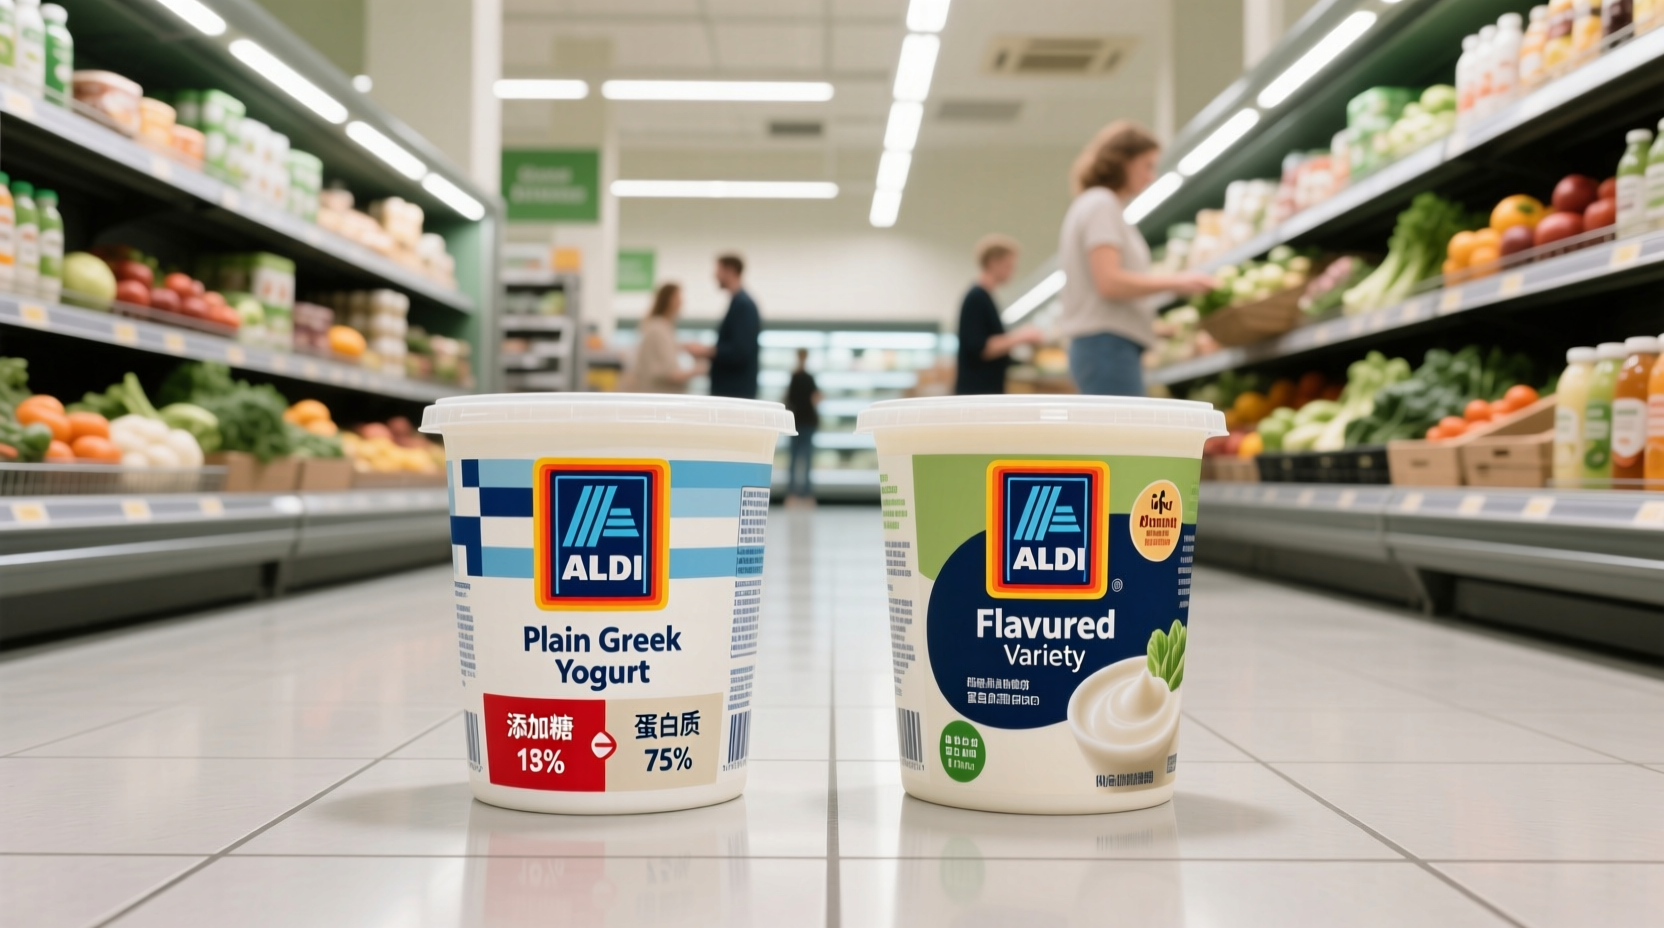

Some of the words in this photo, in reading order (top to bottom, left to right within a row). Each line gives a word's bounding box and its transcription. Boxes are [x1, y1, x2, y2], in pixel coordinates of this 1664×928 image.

[561, 554, 643, 581] ALDI
[1012, 546, 1086, 571] ALDI
[976, 607, 1116, 640] Flavured
[523, 625, 591, 652] Plain
[598, 624, 682, 652] Greek
[1003, 644, 1086, 673] Variety
[554, 659, 650, 692] Yogurt
[506, 712, 574, 741] 添加糖
[634, 709, 701, 740] 蛋白质
[517, 747, 565, 774] 13%
[644, 746, 693, 772] 75%
